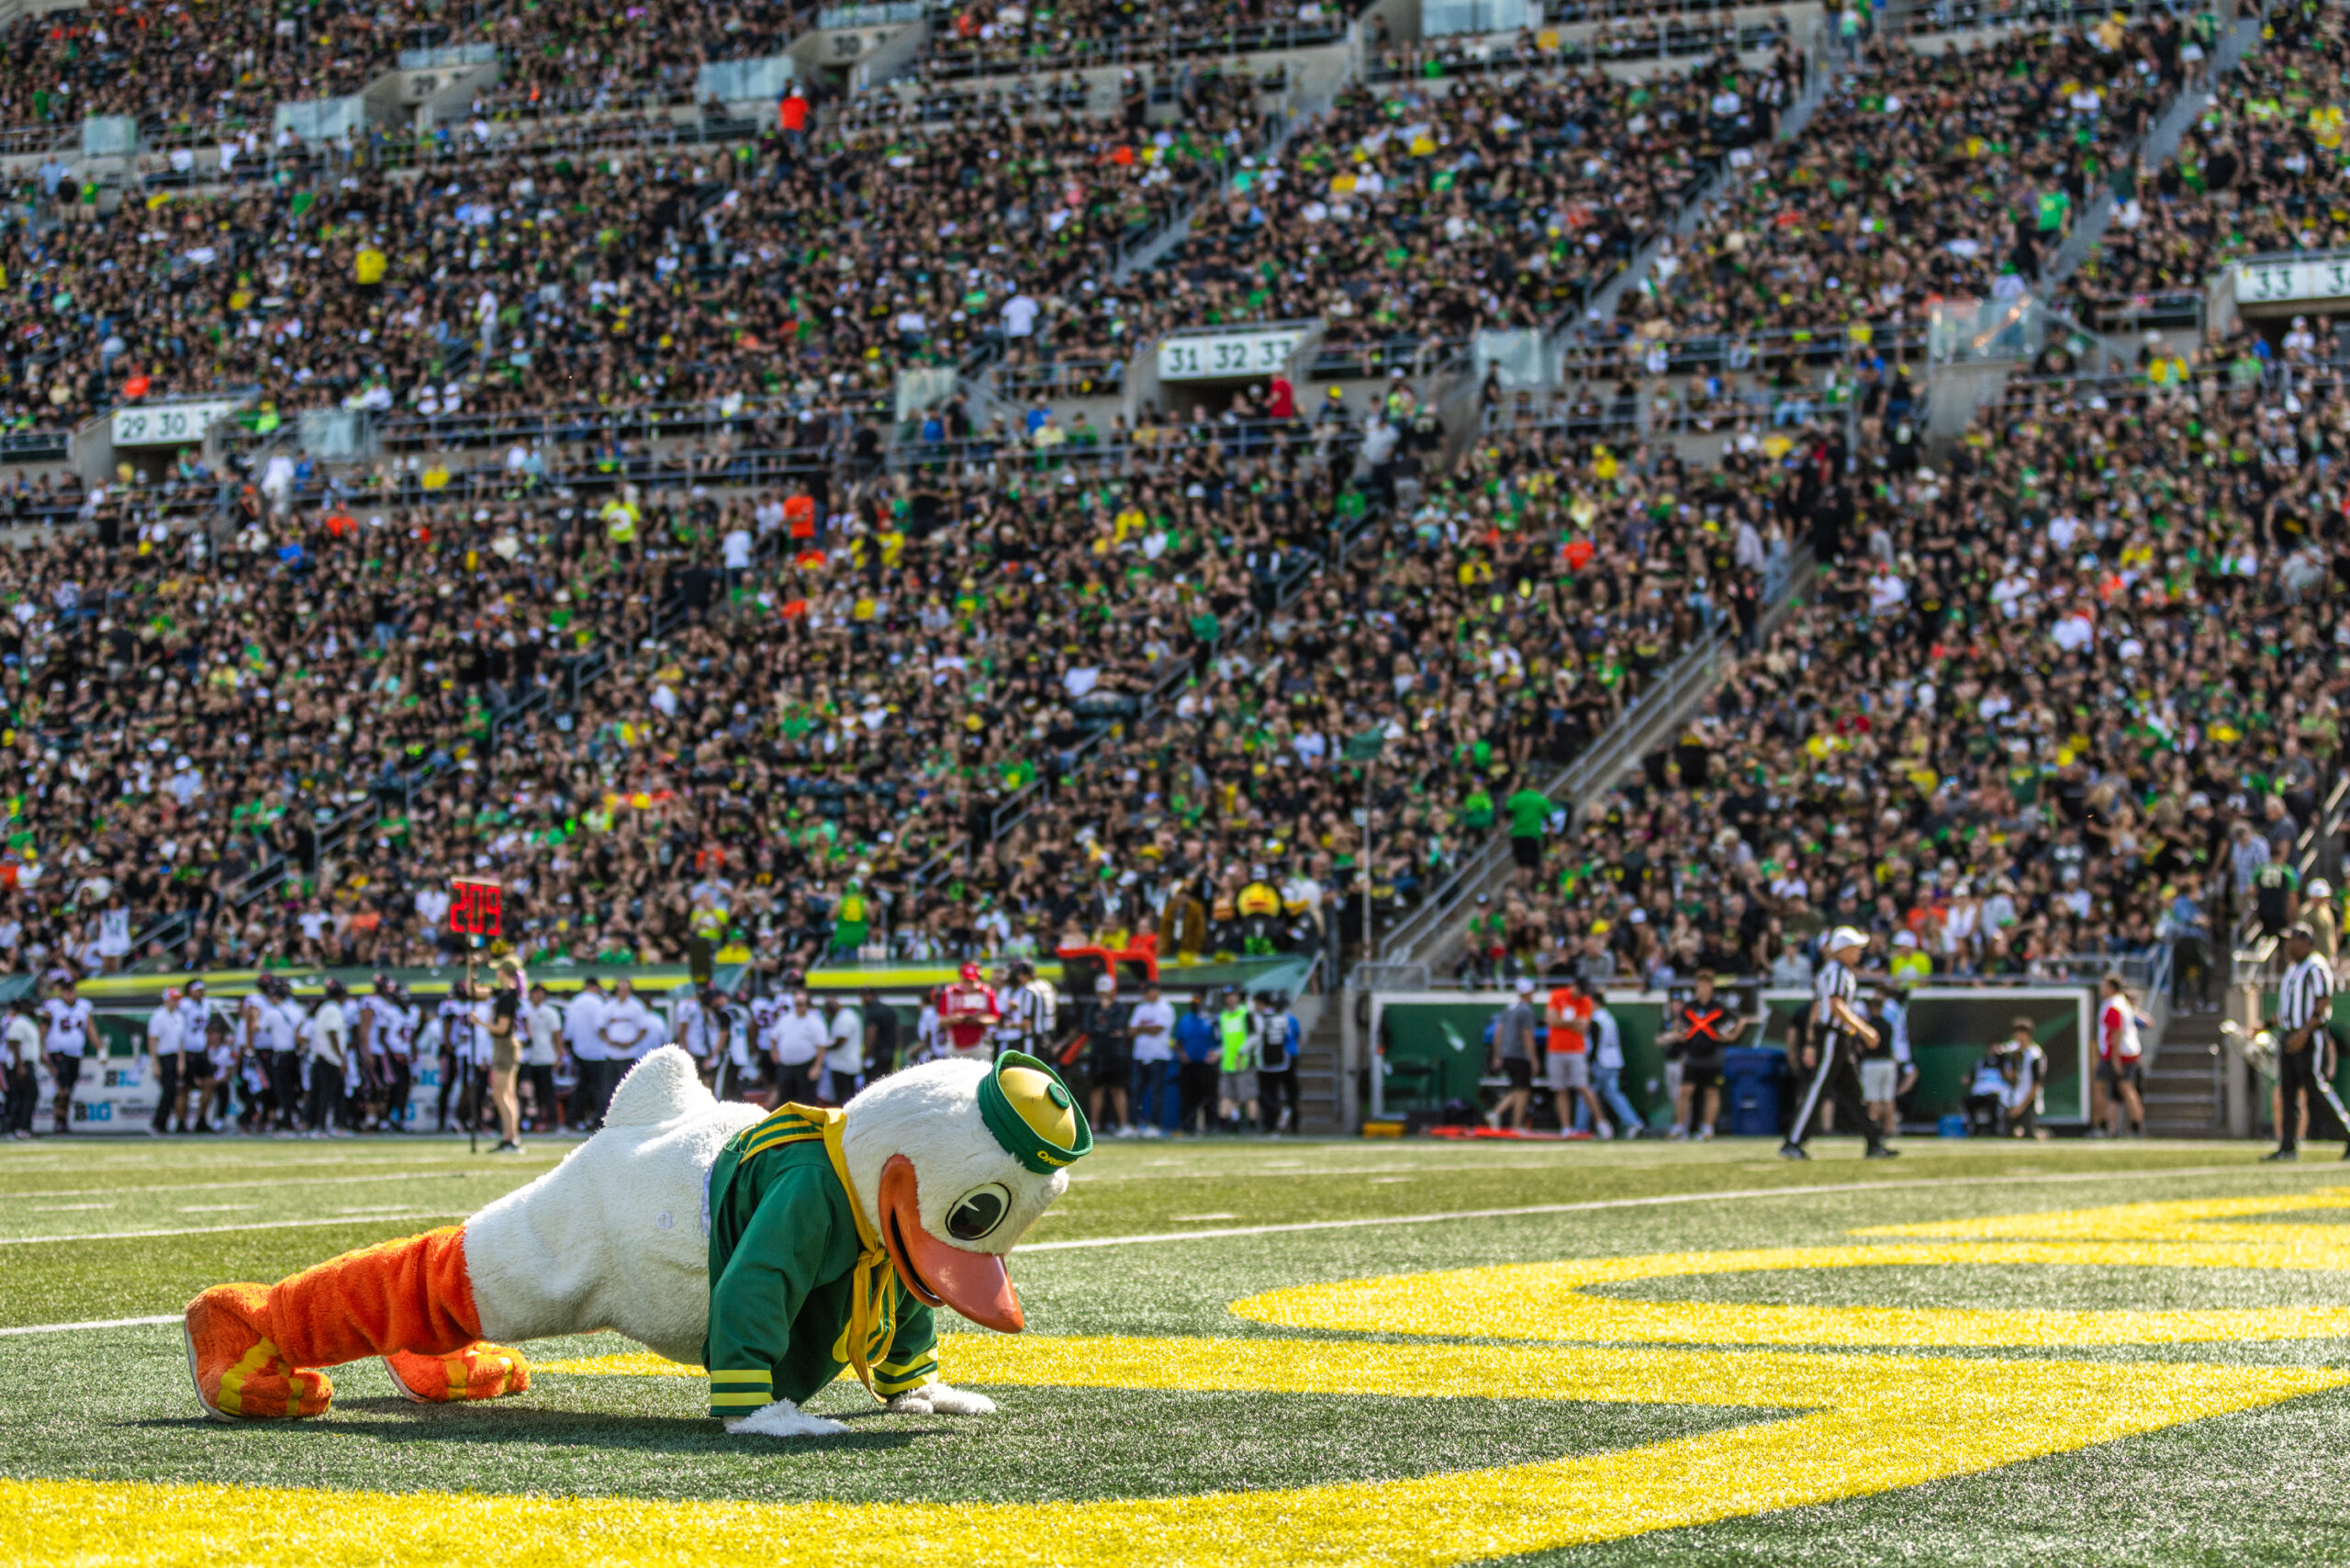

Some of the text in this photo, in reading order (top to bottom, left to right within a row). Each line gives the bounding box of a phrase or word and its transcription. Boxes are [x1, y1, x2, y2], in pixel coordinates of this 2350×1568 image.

[2255, 265, 2350, 298] 33 3
[1169, 347, 1199, 372] 31
[1214, 342, 1248, 369] 32
[120, 416, 147, 440] 29
[159, 412, 187, 436] 30
